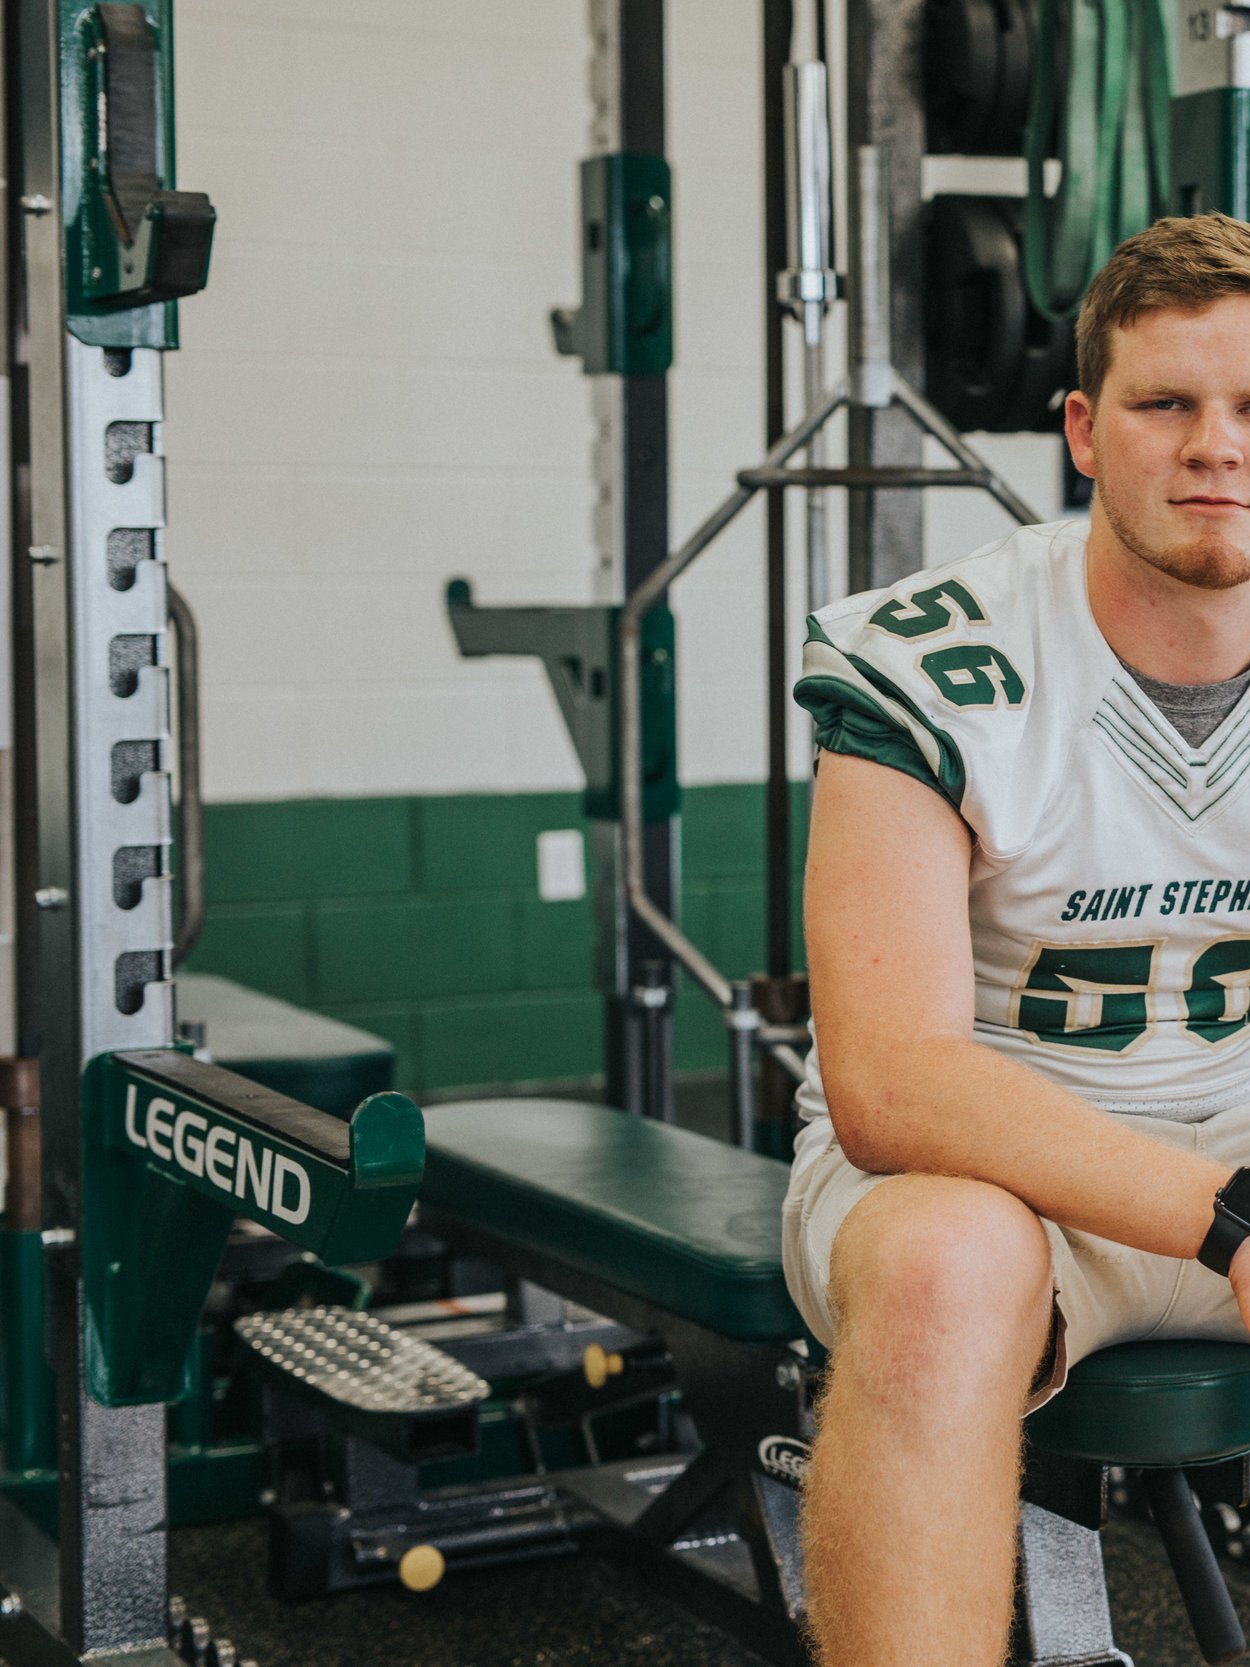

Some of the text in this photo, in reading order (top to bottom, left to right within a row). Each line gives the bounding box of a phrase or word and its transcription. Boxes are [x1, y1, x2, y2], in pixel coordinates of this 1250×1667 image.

[1186, 9, 1211, 41] 13
[864, 575, 1030, 713] 56
[1061, 883, 1153, 922] SAINT
[125, 1083, 311, 1225] LEGEND
[769, 1446, 806, 1476] LEG
